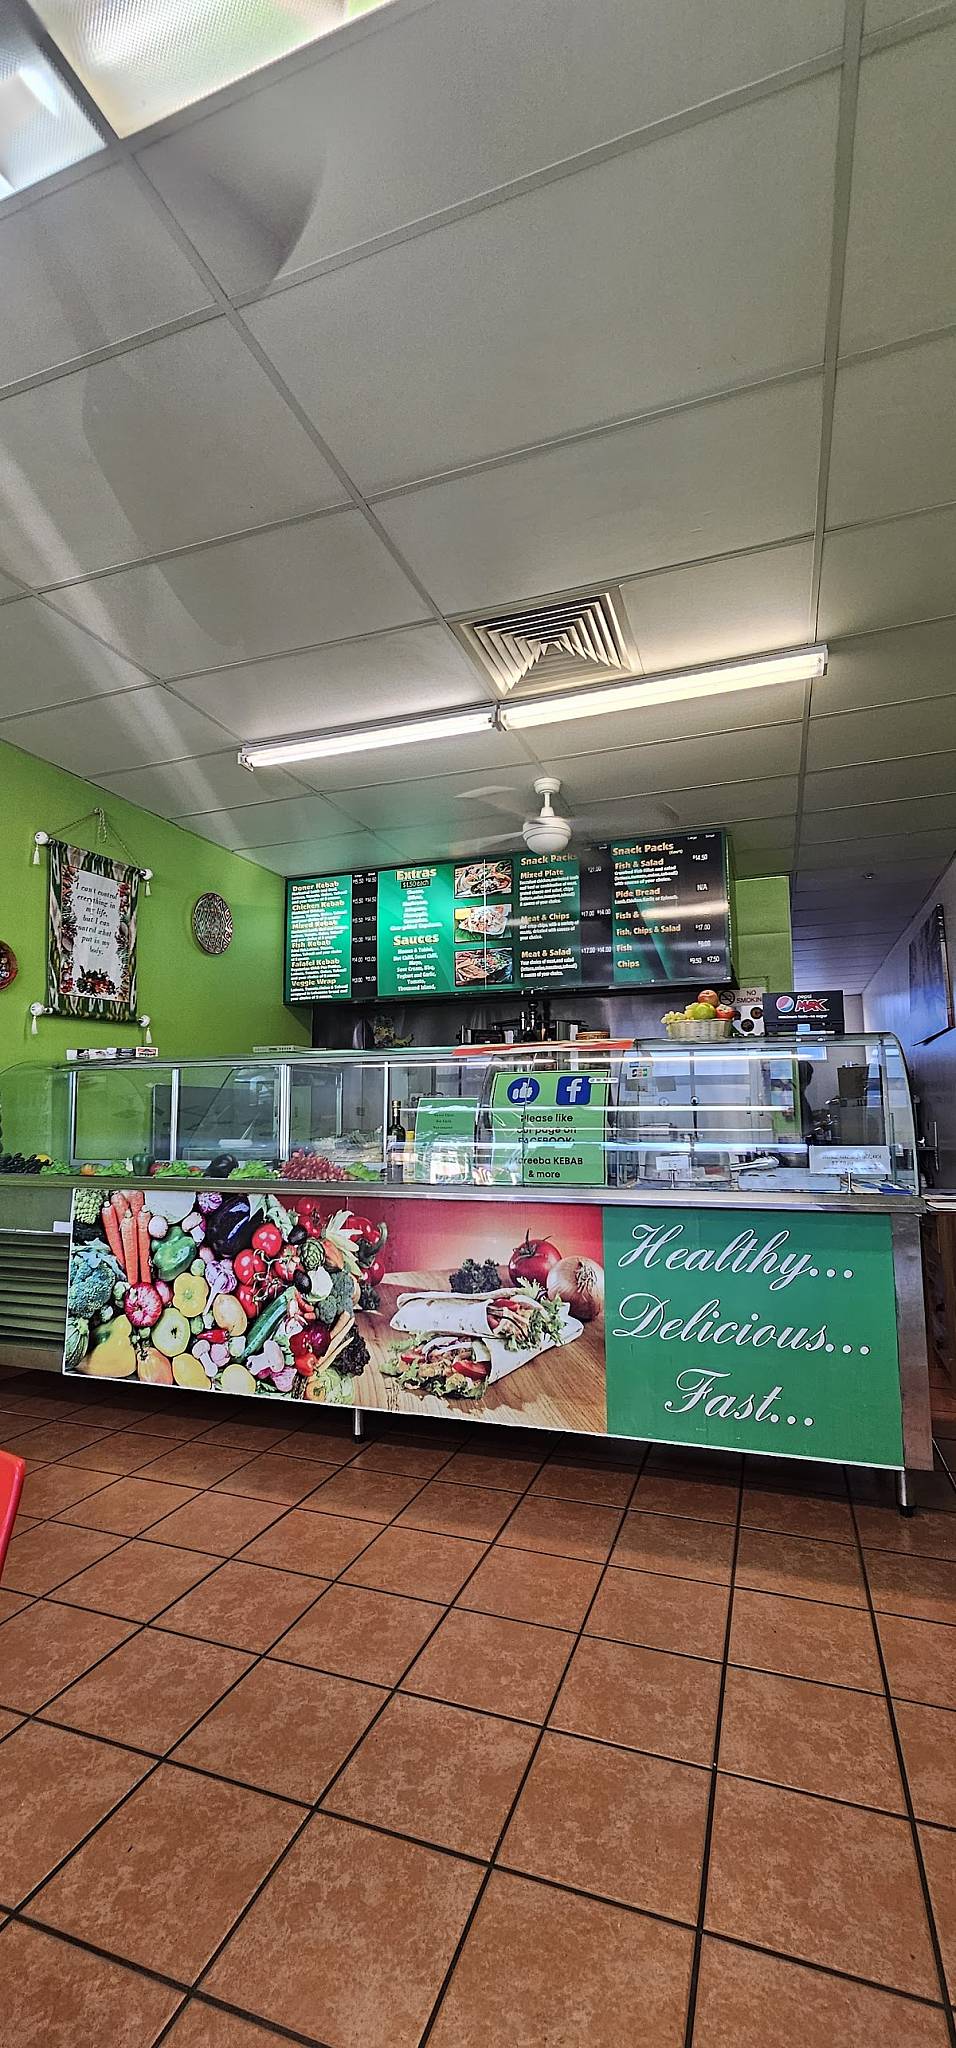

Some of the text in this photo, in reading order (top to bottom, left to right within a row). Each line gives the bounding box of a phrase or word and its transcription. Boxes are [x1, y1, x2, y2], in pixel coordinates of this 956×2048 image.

[612, 841, 674, 856] Snack Packs
[520, 852, 578, 866] Snack Packs
[614, 861, 631, 870] Fish
[640, 857, 664, 867] Salad
[396, 868, 437, 881] Extras
[520, 869, 564, 880] Mixed Plate
[292, 881, 340, 892] Doner Kebab
[403, 880, 417, 888] $1.50
[98, 890, 119, 900] control
[615, 887, 661, 899] Pide Bread
[77, 895, 109, 908] everything
[292, 900, 345, 911] Chicken Kebab
[83, 914, 94, 922] but
[521, 915, 540, 924] Meat
[549, 912, 570, 921] Chips
[615, 910, 640, 920] Fish &
[292, 919, 338, 930] Mixed Kebab
[695, 923, 711, 931] $17.00
[98, 929, 112, 937] what
[616, 928, 633, 937] Fish,
[633, 926, 653, 935] Chips
[660, 924, 681, 933] Salad
[102, 940, 110, 948] my
[307, 939, 331, 947] Kebab
[393, 934, 439, 945] Sauces
[521, 951, 540, 959] Meat
[549, 948, 571, 956] Salad
[616, 944, 633, 952] Fish
[291, 957, 340, 968] Falafel Kebab
[617, 960, 640, 969] Chips
[291, 979, 316, 987] Veggie
[736, 996, 762, 1004] SMOKIN
[520, 1113, 574, 1123] Please like
[535, 1126, 561, 1136] page
[563, 1126, 577, 1134] on
[553, 1156, 583, 1165] KEBAB
[528, 1169, 534, 1178] &
[618, 1223, 853, 1291] Healthy...
[613, 1292, 871, 1356] Delicious...
[664, 1367, 815, 1427] Fast...
